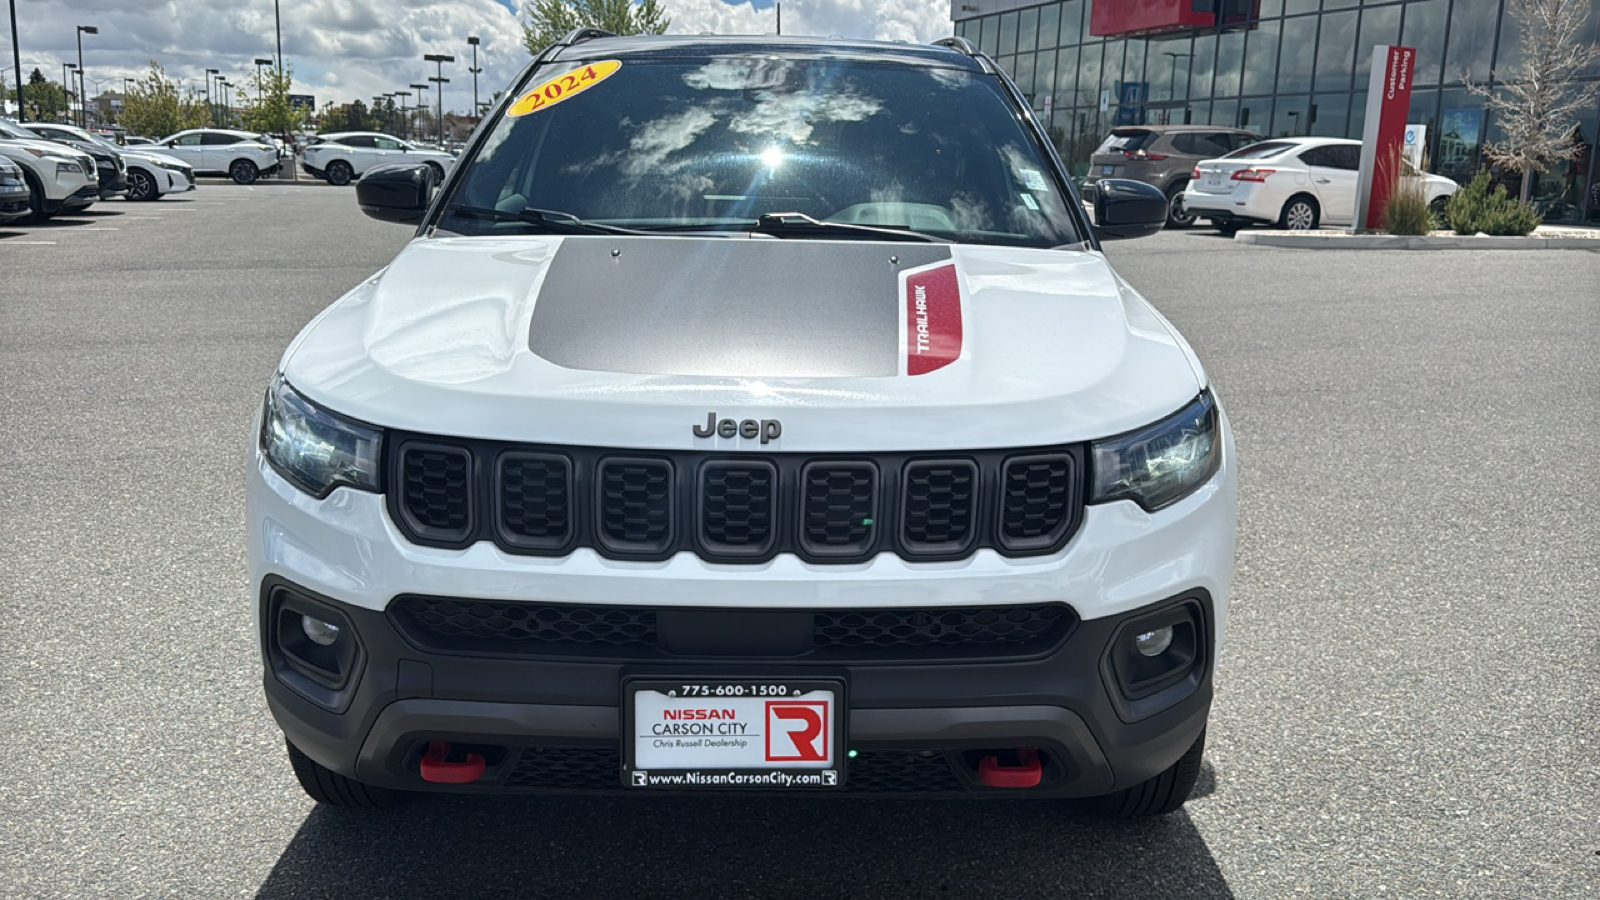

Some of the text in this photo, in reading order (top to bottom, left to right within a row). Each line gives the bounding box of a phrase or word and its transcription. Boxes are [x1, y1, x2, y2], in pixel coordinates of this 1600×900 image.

[1387, 50, 1400, 100] Customer
[1398, 50, 1411, 90] Parking
[525, 65, 598, 110] 2024
[914, 284, 930, 355] TRAILHAWK
[693, 412, 782, 444] Jeep
[681, 685, 787, 696] 775-600-1500
[663, 709, 735, 720] NISSAN
[652, 722, 748, 735] CARSON CITY
[653, 738, 747, 749] Chris Russell Dealership
[649, 771, 821, 787] www.NissanCarsonCity.com
